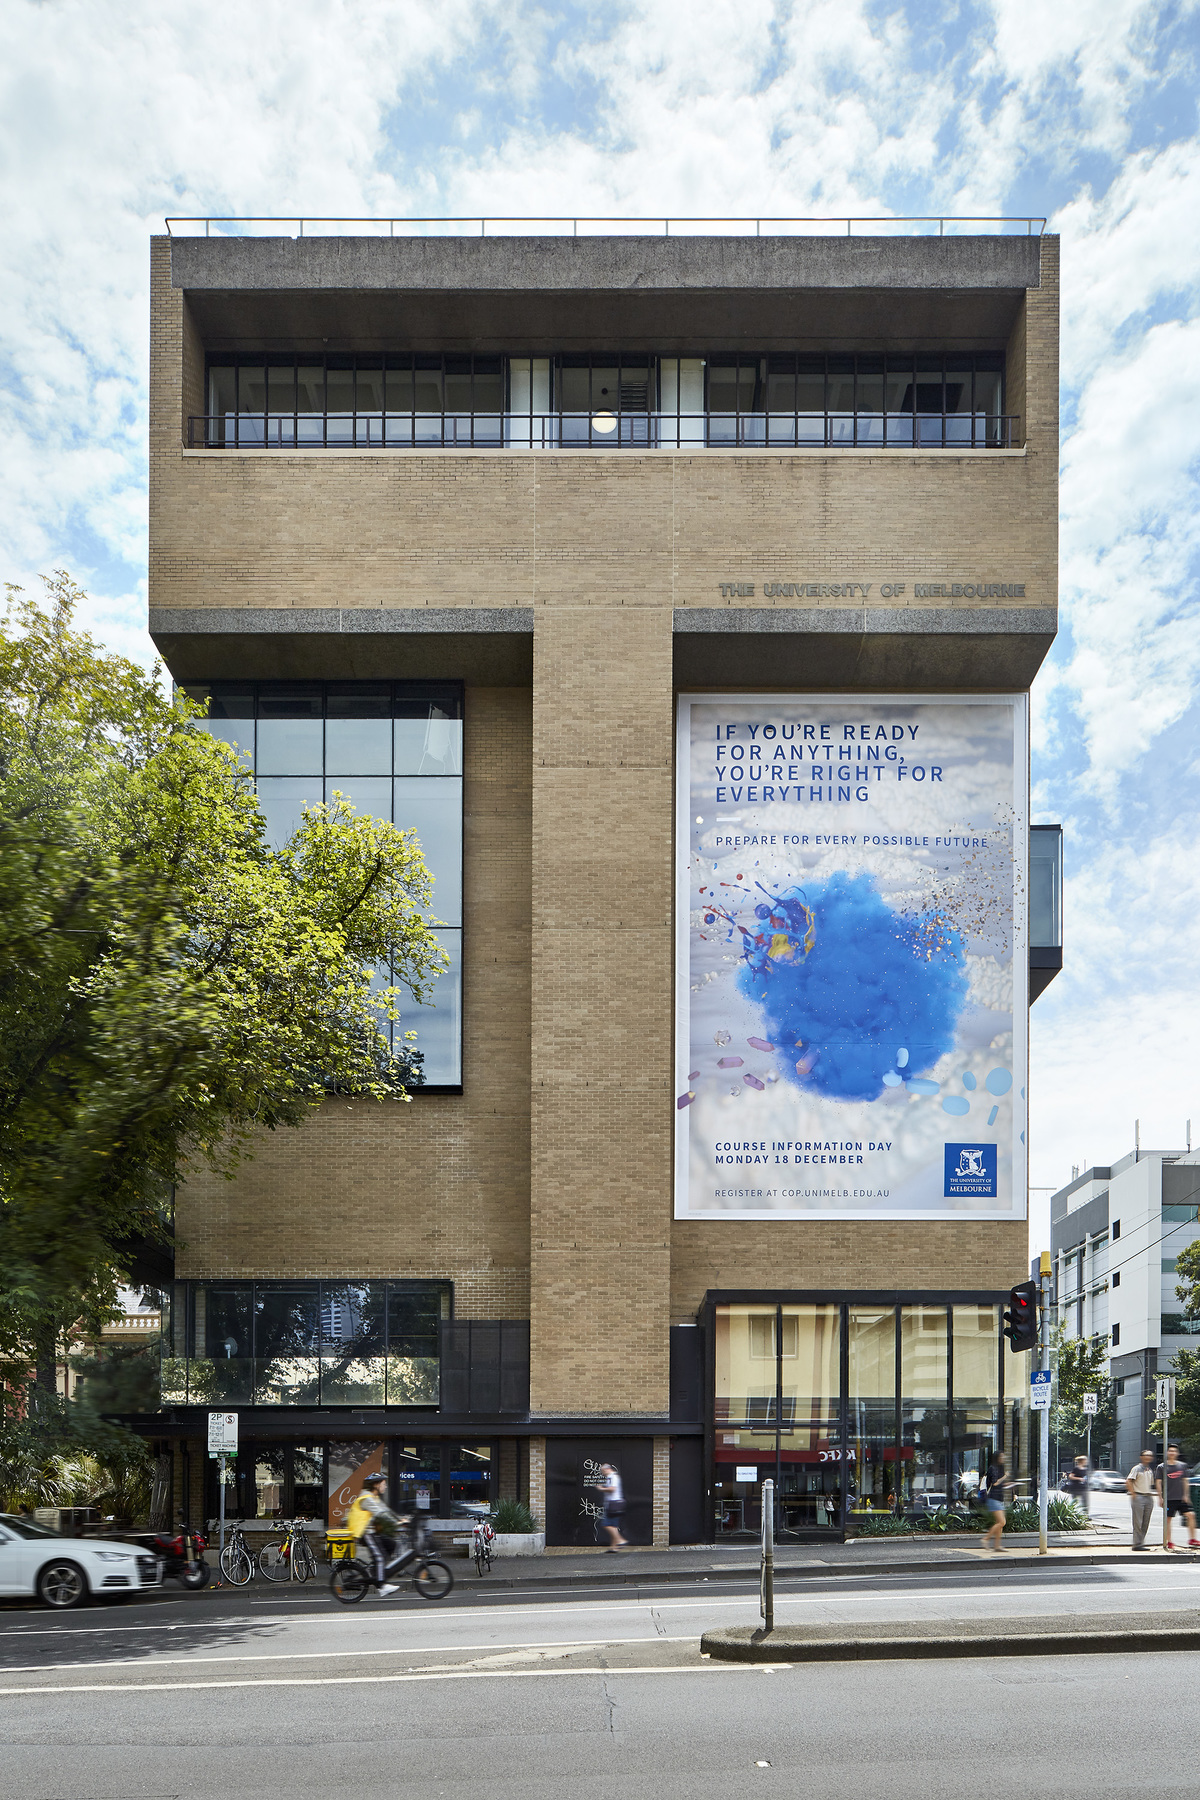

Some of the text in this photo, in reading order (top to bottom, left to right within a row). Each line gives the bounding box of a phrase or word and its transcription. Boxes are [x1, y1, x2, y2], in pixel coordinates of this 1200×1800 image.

[719, 583, 1026, 598] THE UNIVERSITY OF MELBOURNE
[716, 724, 920, 741] IF YOU'RE READY
[716, 745, 905, 764] FOR ANYTHING,
[715, 765, 943, 782] YOU'RE RIGHT FOR
[716, 786, 869, 802] EVERYTHING
[716, 835, 988, 848] PREPARE FOR EVERY POSSIBLE FUTURE
[715, 1142, 892, 1151] COURSE INFORMATION DAY
[715, 1155, 864, 1164] MONDAY 18 DECEMBER
[715, 1189, 890, 1197] REGISTER AT COP.UNIMELB.EDU.AU
[211, 1413, 222, 1421] 2P
